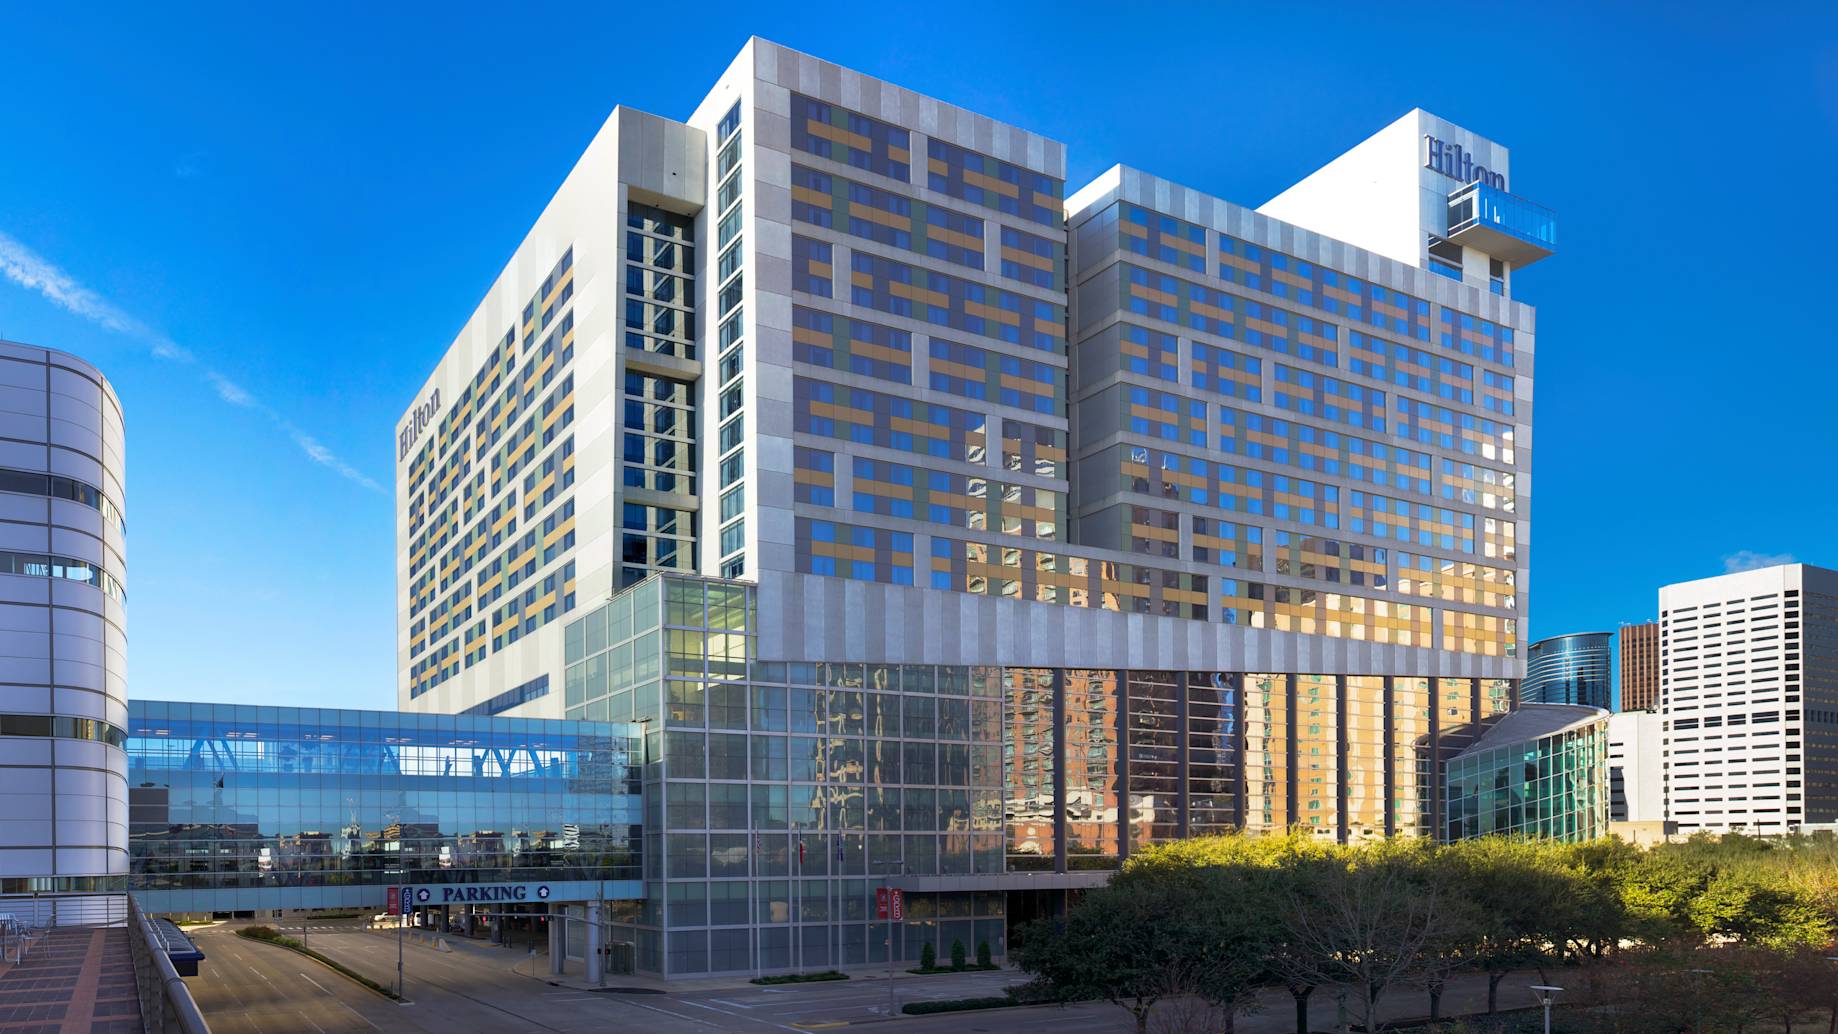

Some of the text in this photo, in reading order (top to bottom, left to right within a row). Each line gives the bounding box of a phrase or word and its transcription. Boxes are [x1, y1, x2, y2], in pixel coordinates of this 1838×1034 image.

[1424, 133, 1505, 192] Hilton
[399, 387, 441, 463] Hilton
[442, 885, 526, 902] PARKING
